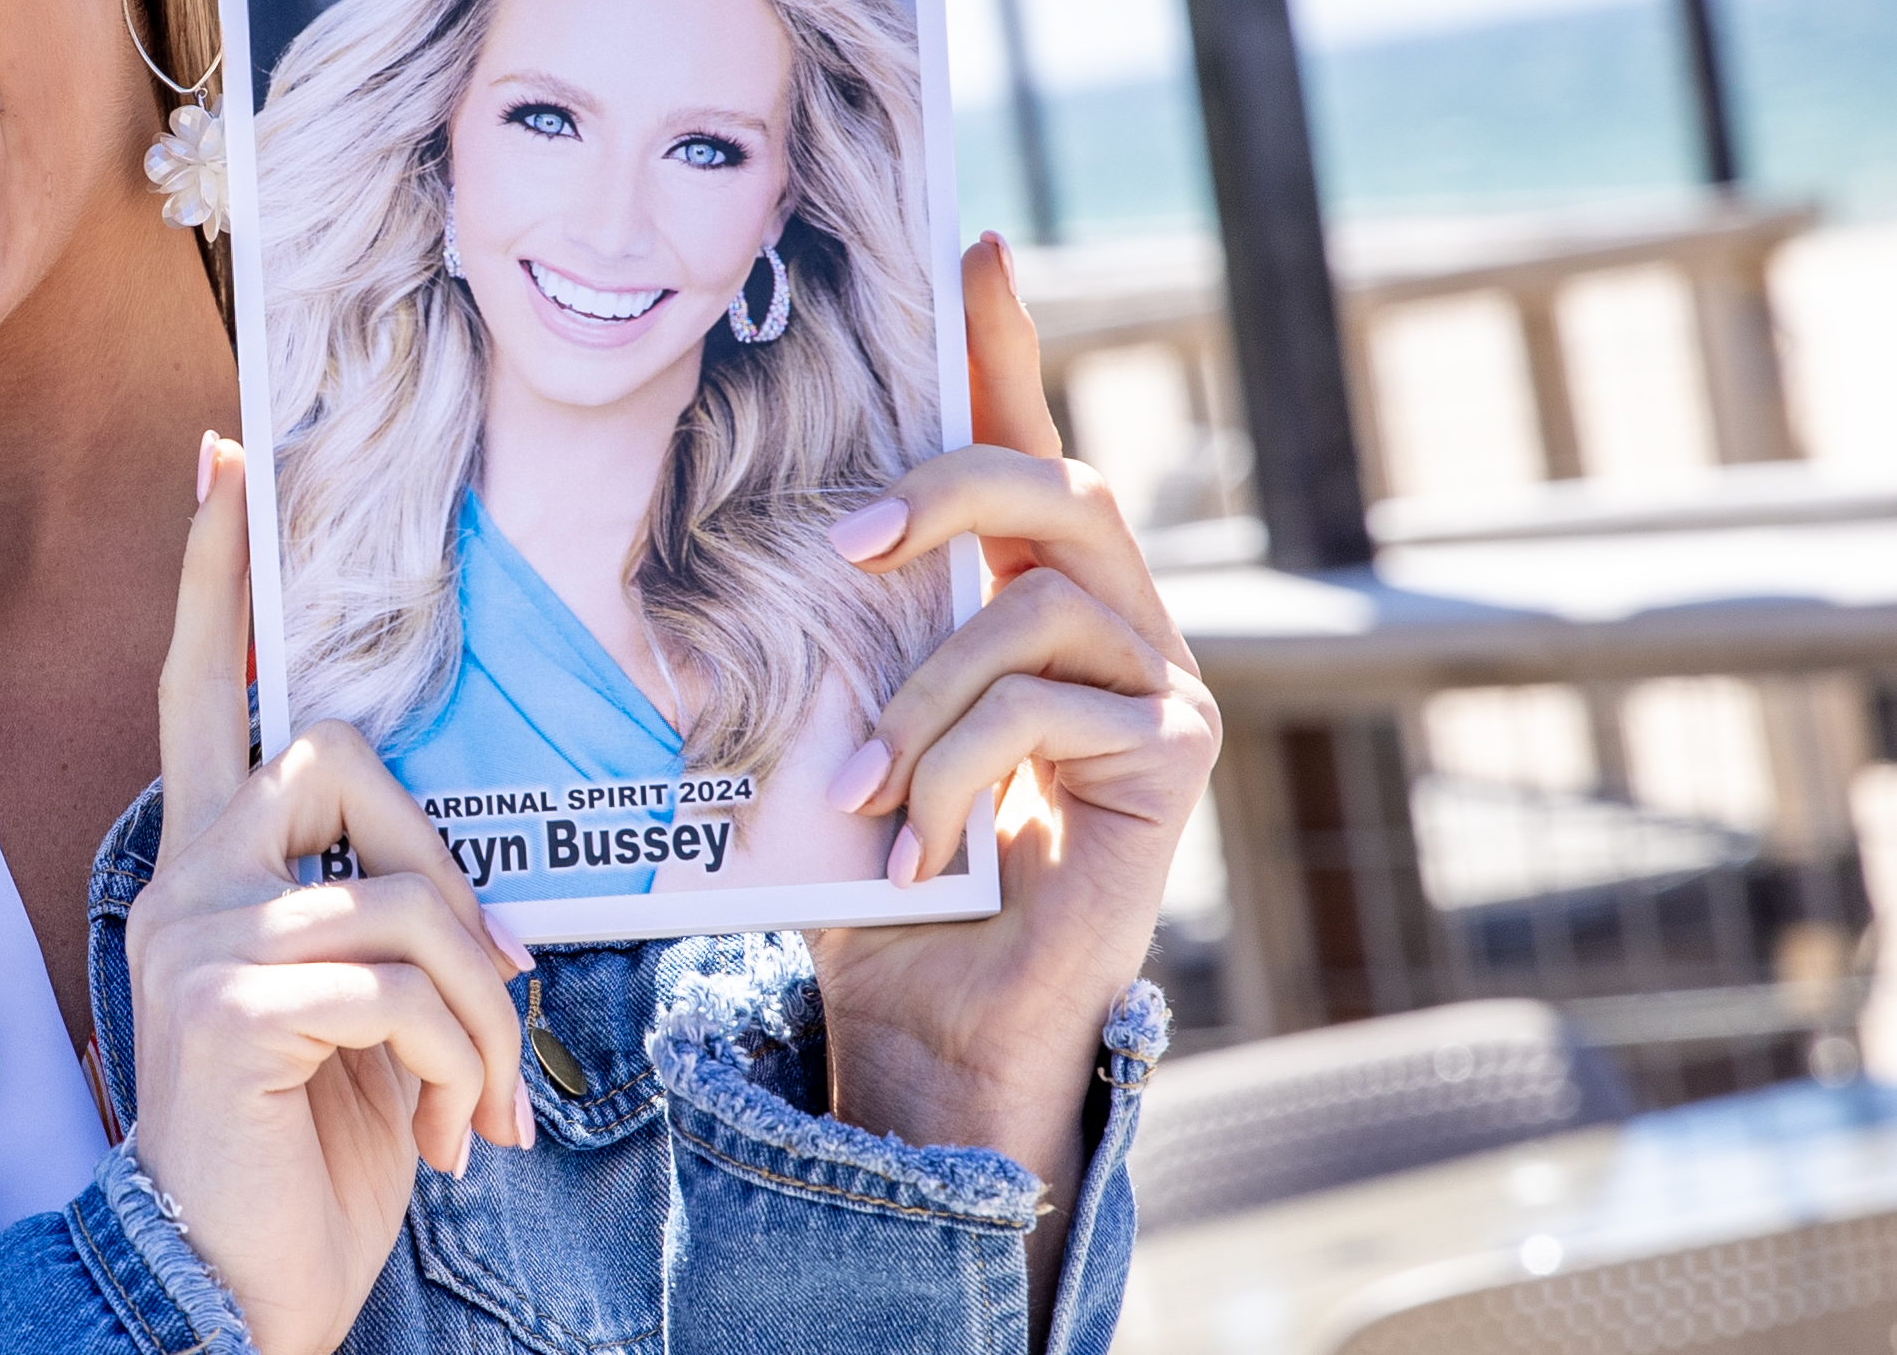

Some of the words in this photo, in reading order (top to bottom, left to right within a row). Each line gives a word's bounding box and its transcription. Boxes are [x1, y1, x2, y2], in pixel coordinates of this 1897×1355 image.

[424, 790, 557, 819] ARDINAL
[567, 784, 669, 811] SPIRIT
[679, 778, 753, 804] 2024
[546, 818, 731, 873] Bussey
